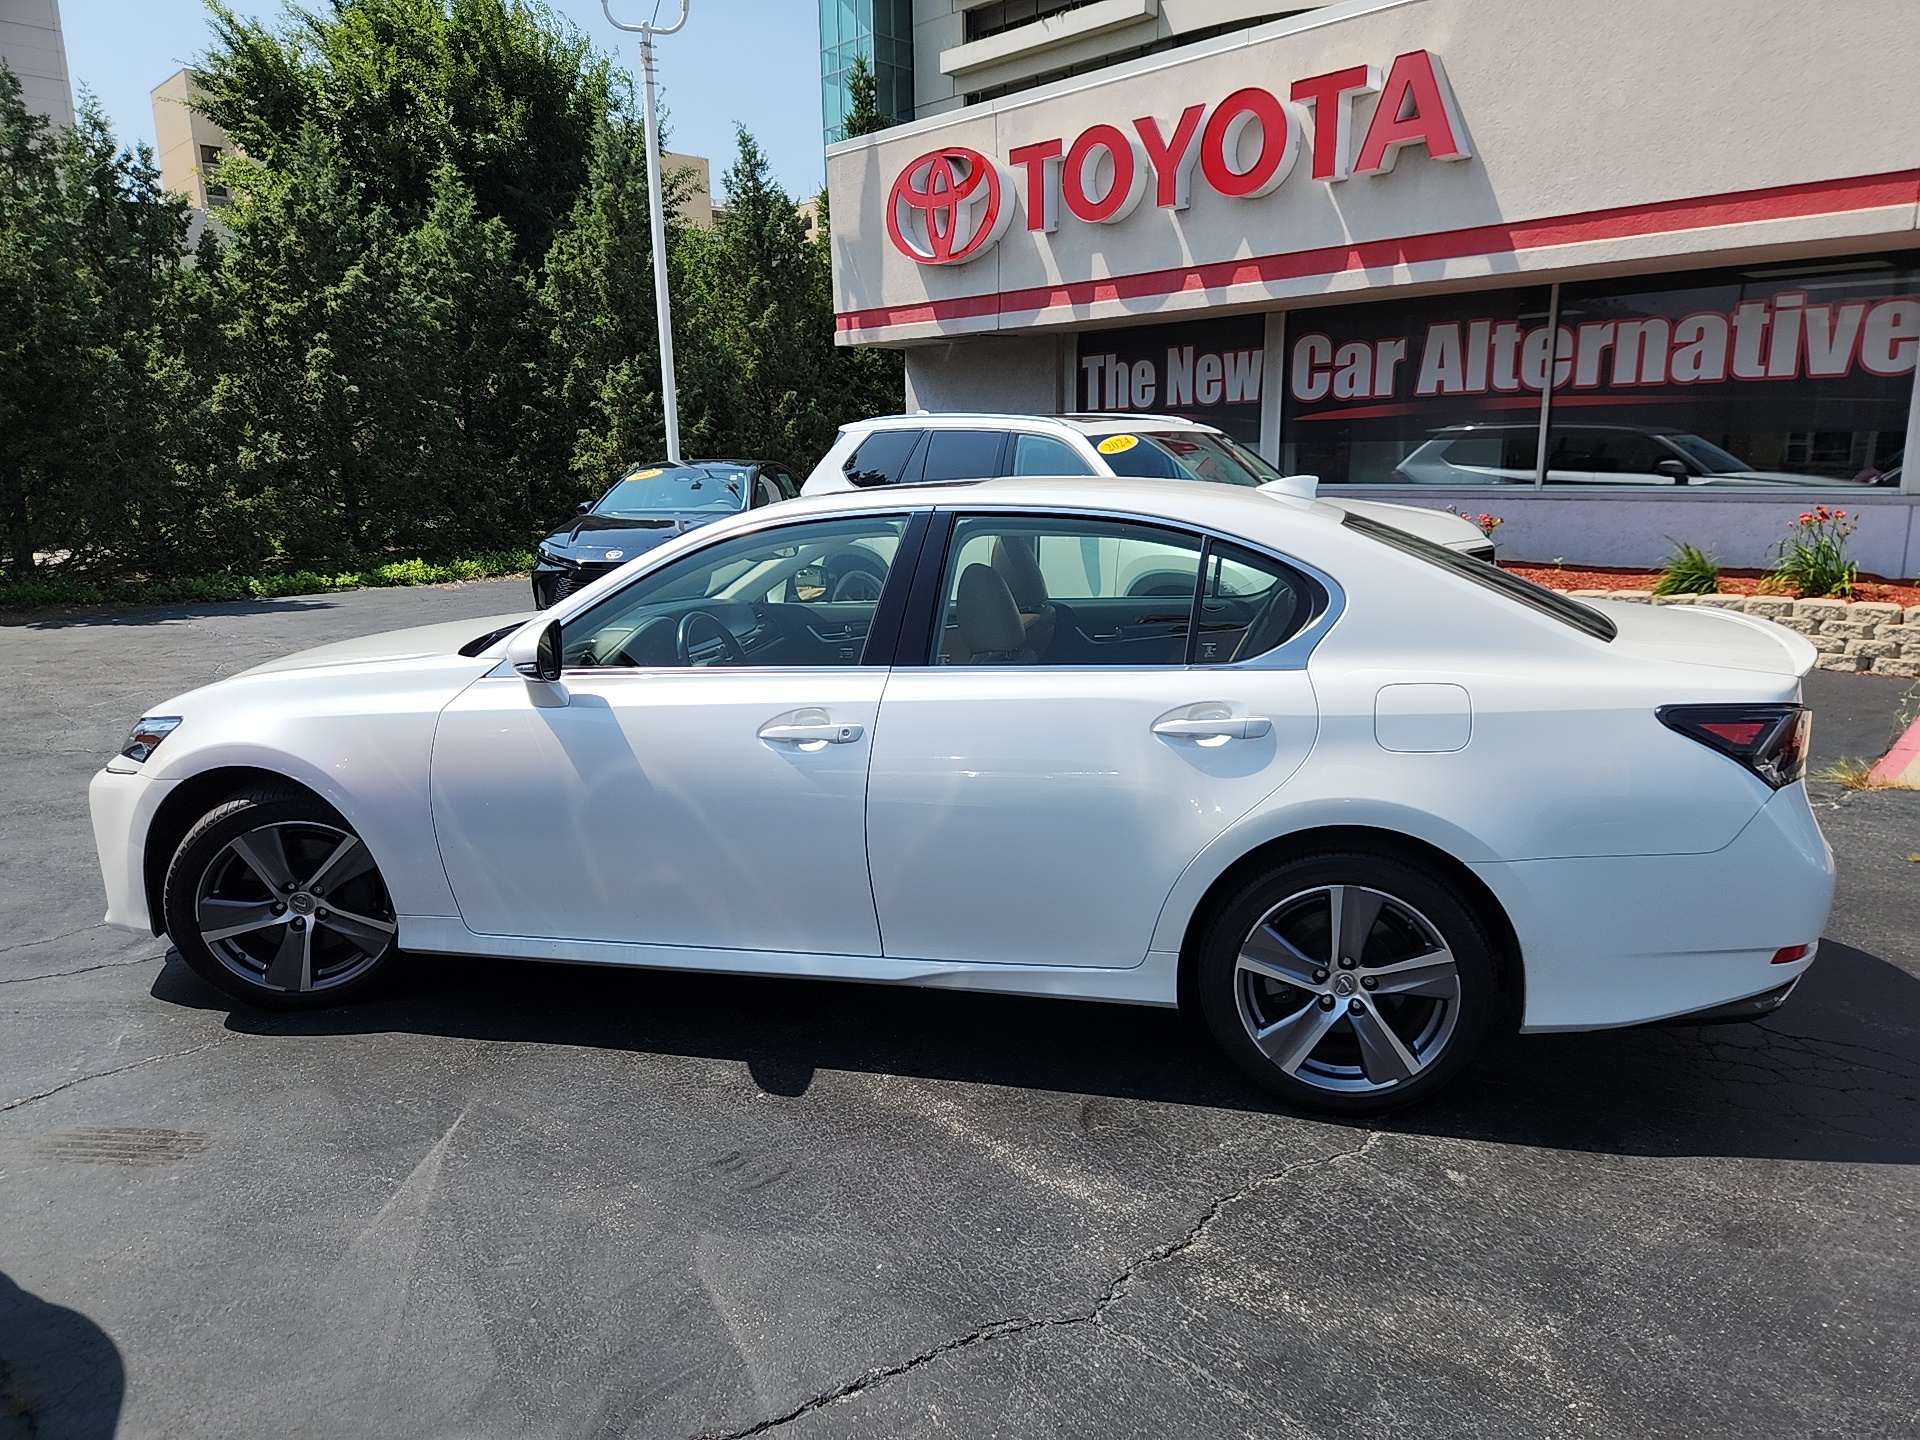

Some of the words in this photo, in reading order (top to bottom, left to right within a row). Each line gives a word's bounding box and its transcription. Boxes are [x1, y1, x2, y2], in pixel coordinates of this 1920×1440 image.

[1009, 49, 1470, 232] TOYOTA
[1081, 353, 1156, 411] The
[1165, 345, 1264, 408] New
[1291, 332, 1407, 402] Car
[1413, 290, 1920, 396] Alternative
[1104, 436, 1132, 452] 2024
